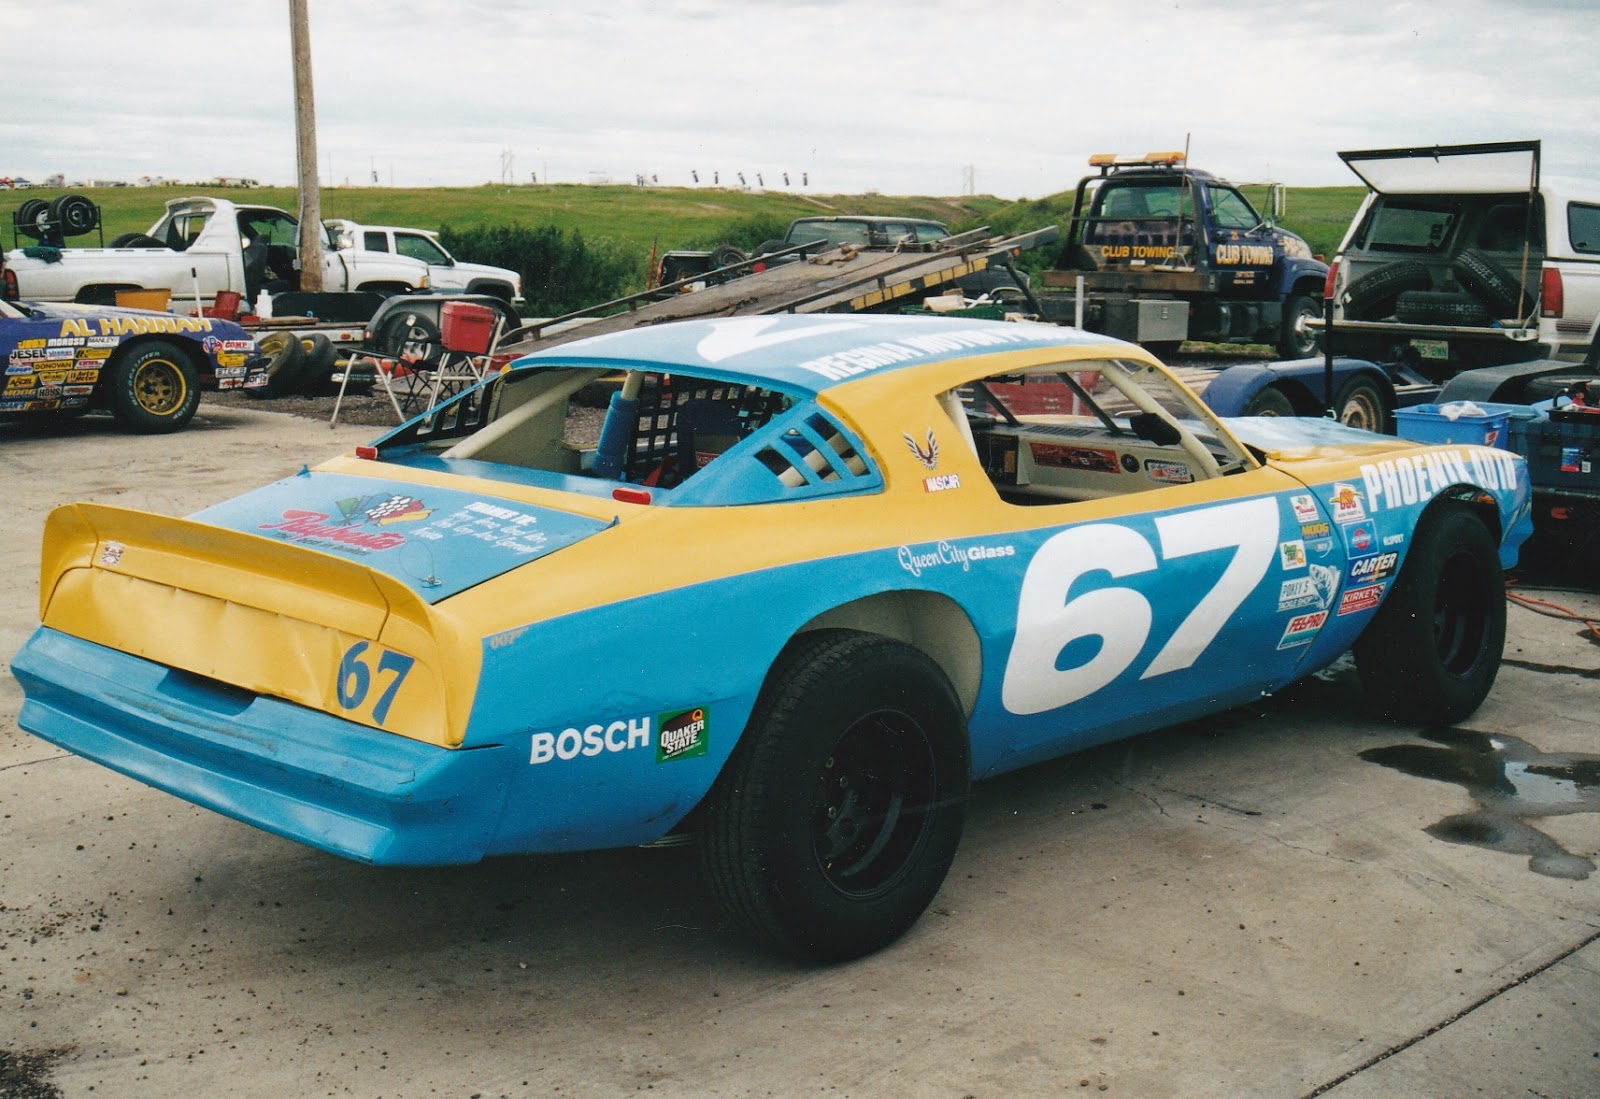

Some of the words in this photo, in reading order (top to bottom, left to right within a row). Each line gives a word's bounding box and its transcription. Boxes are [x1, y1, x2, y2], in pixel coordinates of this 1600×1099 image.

[1101, 245, 1130, 258] CLUB
[1132, 245, 1175, 258] TOWING
[1216, 244, 1240, 265] CLUB
[1240, 245, 1274, 266] TOWING
[60, 319, 97, 337] AL
[99, 317, 213, 336] HANNAH
[11, 348, 46, 359] JESEL
[799, 341, 924, 381] REGINA
[35, 361, 71, 370] DONOVAN
[2, 389, 36, 397] MOOG
[922, 473, 961, 493] NASCAR
[1360, 450, 1475, 513] PHOENIX
[1468, 448, 1518, 491] AUTO
[898, 545, 940, 577] Queen
[938, 540, 969, 572] City
[967, 545, 1016, 561] Glass
[1350, 552, 1398, 577] CARTER
[1002, 496, 1280, 715] 67
[1343, 588, 1377, 604] KIRKEY
[1287, 612, 1326, 634] FEL-PRO
[336, 640, 415, 727] 67
[529, 717, 651, 766] BOSCH
[660, 719, 705, 748] QUAKER
[665, 732, 699, 754] STATE
